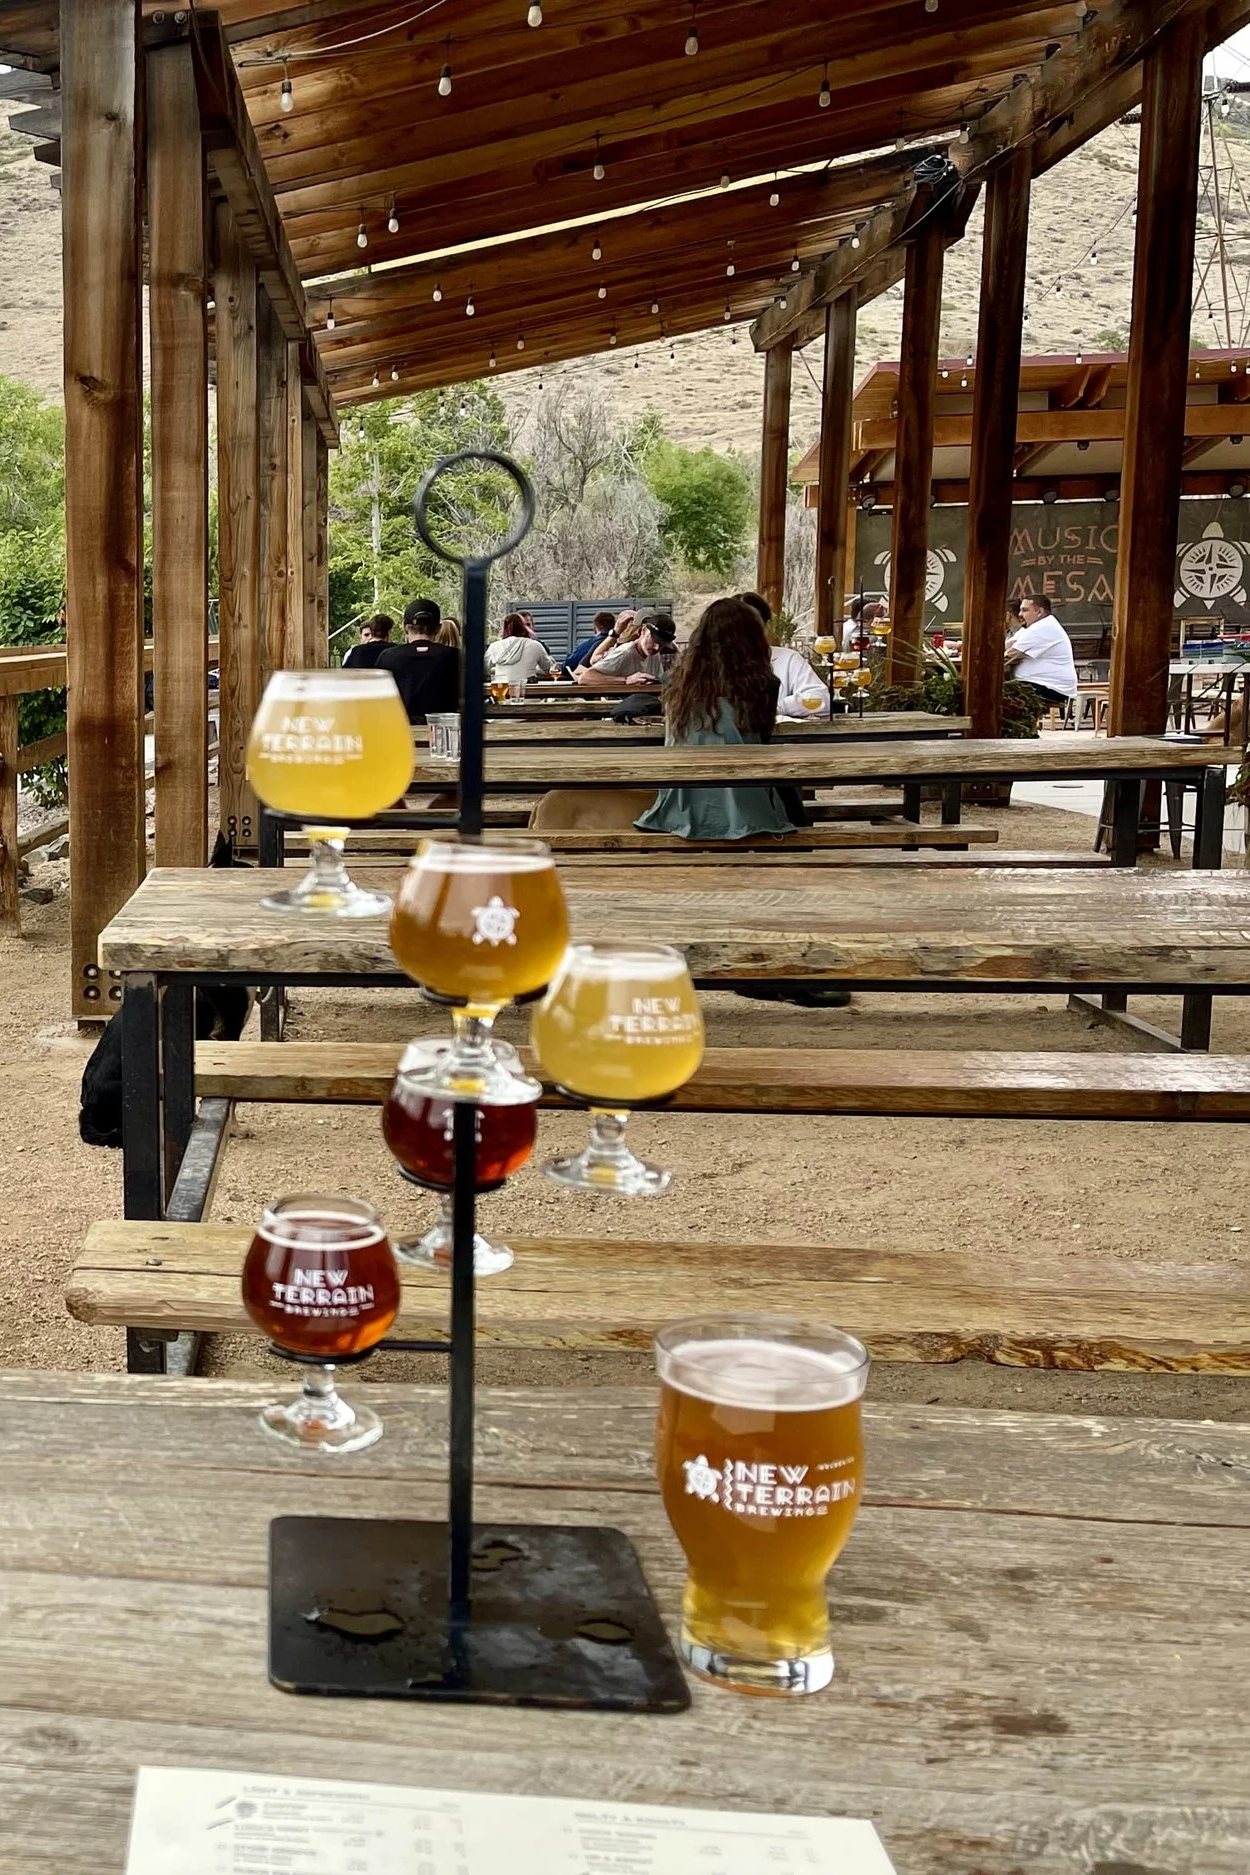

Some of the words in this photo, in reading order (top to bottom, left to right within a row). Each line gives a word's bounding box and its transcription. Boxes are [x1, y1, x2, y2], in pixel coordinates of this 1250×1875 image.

[1010, 525, 1119, 555] MUSIC
[1038, 555, 1055, 566] BY
[1059, 554, 1085, 565] THE
[1010, 571, 1114, 602] MESA
[281, 715, 336, 734] NEW
[261, 733, 363, 753] TERRAIN
[631, 997, 681, 1014] NEW
[294, 1268, 348, 1288] NEW
[272, 1282, 374, 1306] TERRAIN
[735, 1461, 809, 1485] NEW
[736, 1478, 855, 1506] TERRAIN
